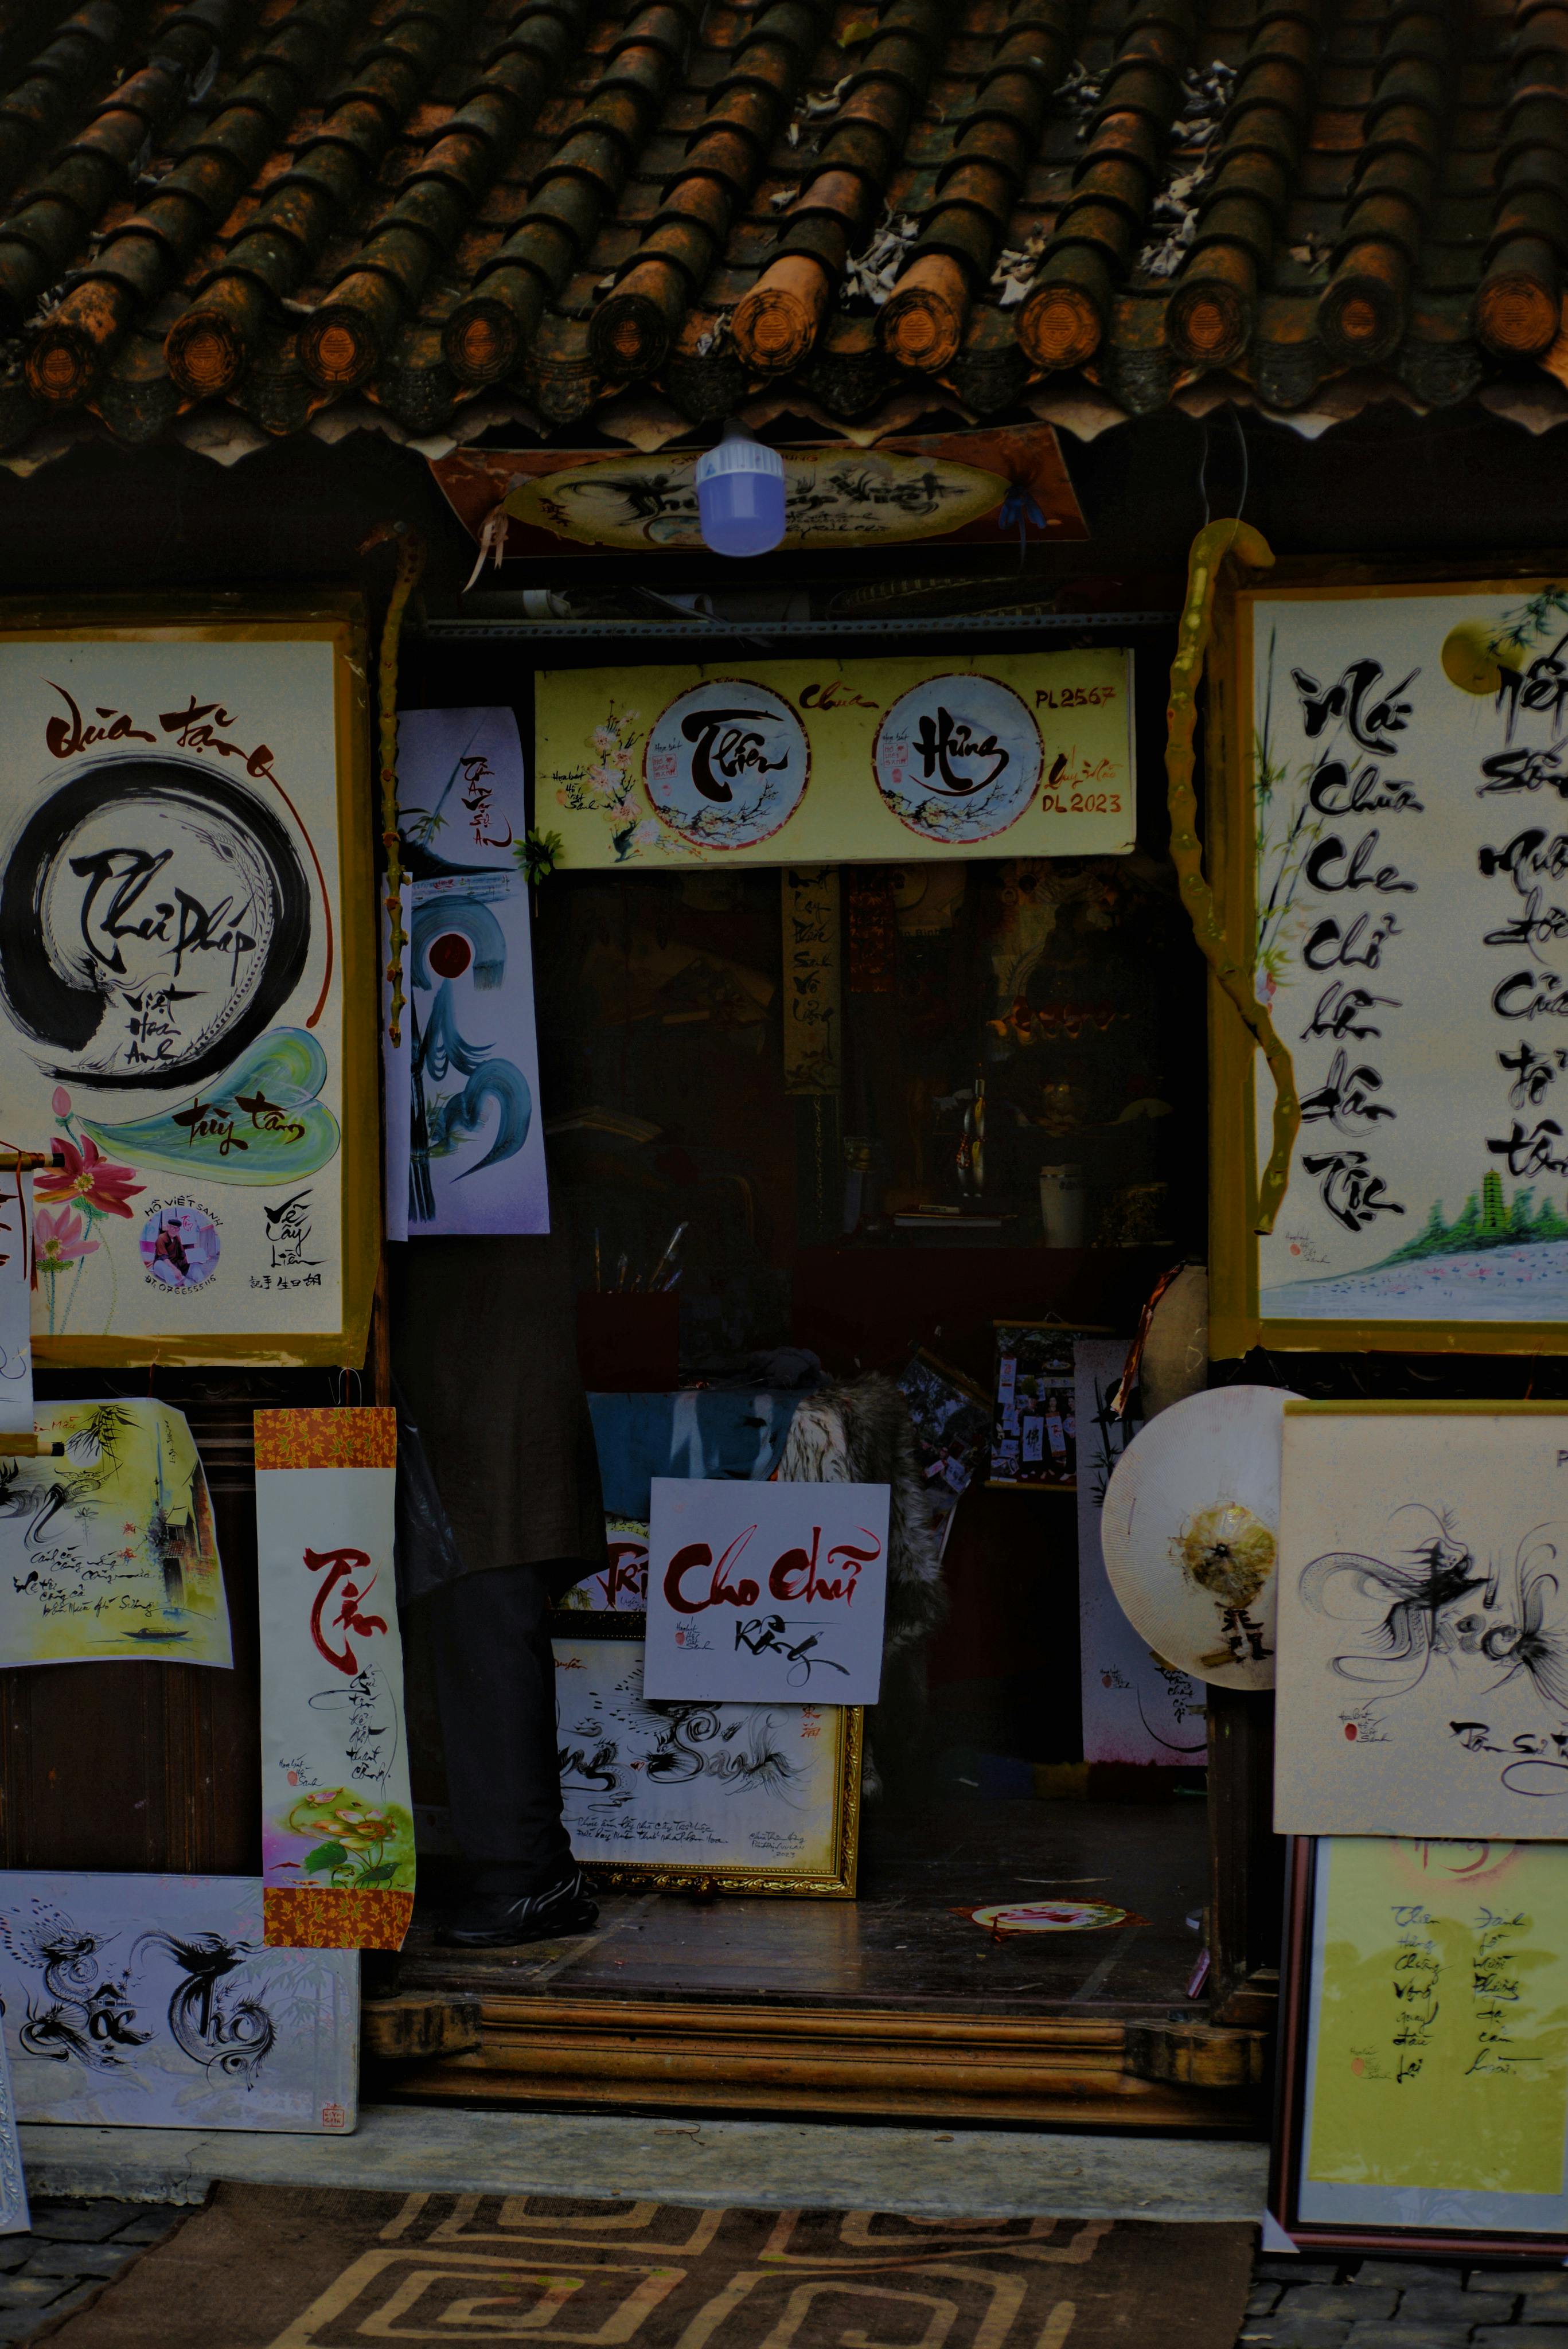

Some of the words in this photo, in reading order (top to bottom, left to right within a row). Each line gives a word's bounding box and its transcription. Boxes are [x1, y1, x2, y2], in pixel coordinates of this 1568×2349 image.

[799, 681, 879, 711] Chùa
[39, 676, 156, 758] Quà
[468, 781, 492, 796] An
[1309, 758, 1425, 817] Chùa
[1305, 828, 1418, 893] Che
[124, 1017, 181, 1043] Hoa
[124, 1039, 182, 1064] Anh
[145, 1199, 162, 1216] HỒ
[196, 1204, 224, 1227] SANH
[664, 1525, 760, 1614] Cho
